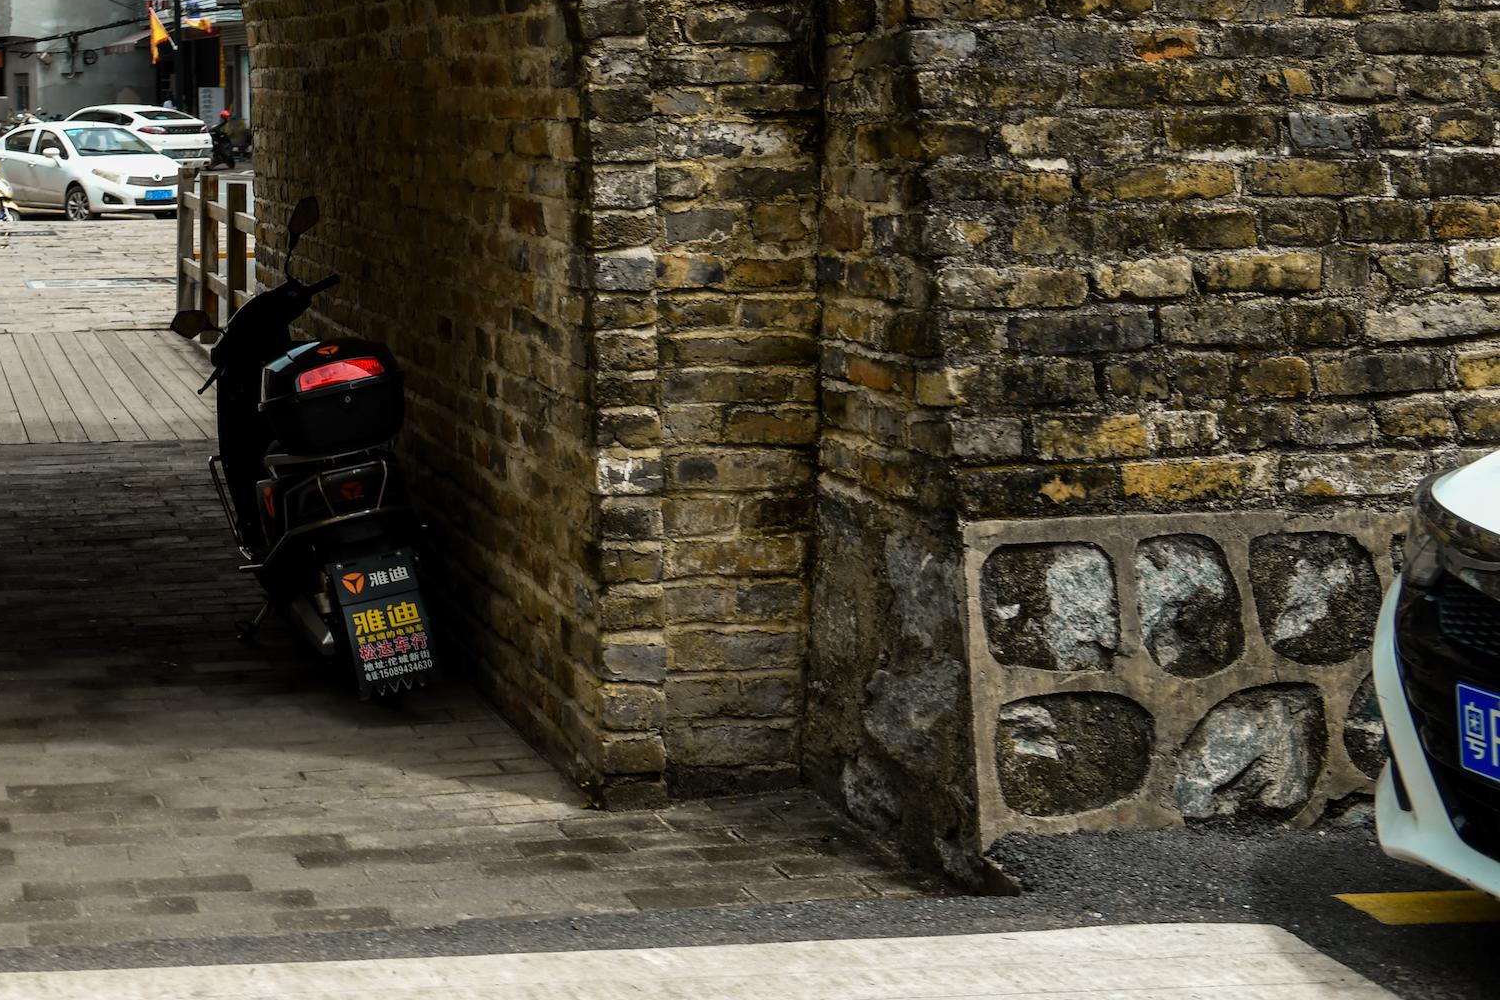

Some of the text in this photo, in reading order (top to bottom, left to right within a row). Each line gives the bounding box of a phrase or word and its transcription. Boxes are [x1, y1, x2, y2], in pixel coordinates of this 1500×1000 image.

[368, 566, 410, 587] 雅迪
[352, 601, 421, 636] 雅迪
[358, 631, 428, 662] 松达车行
